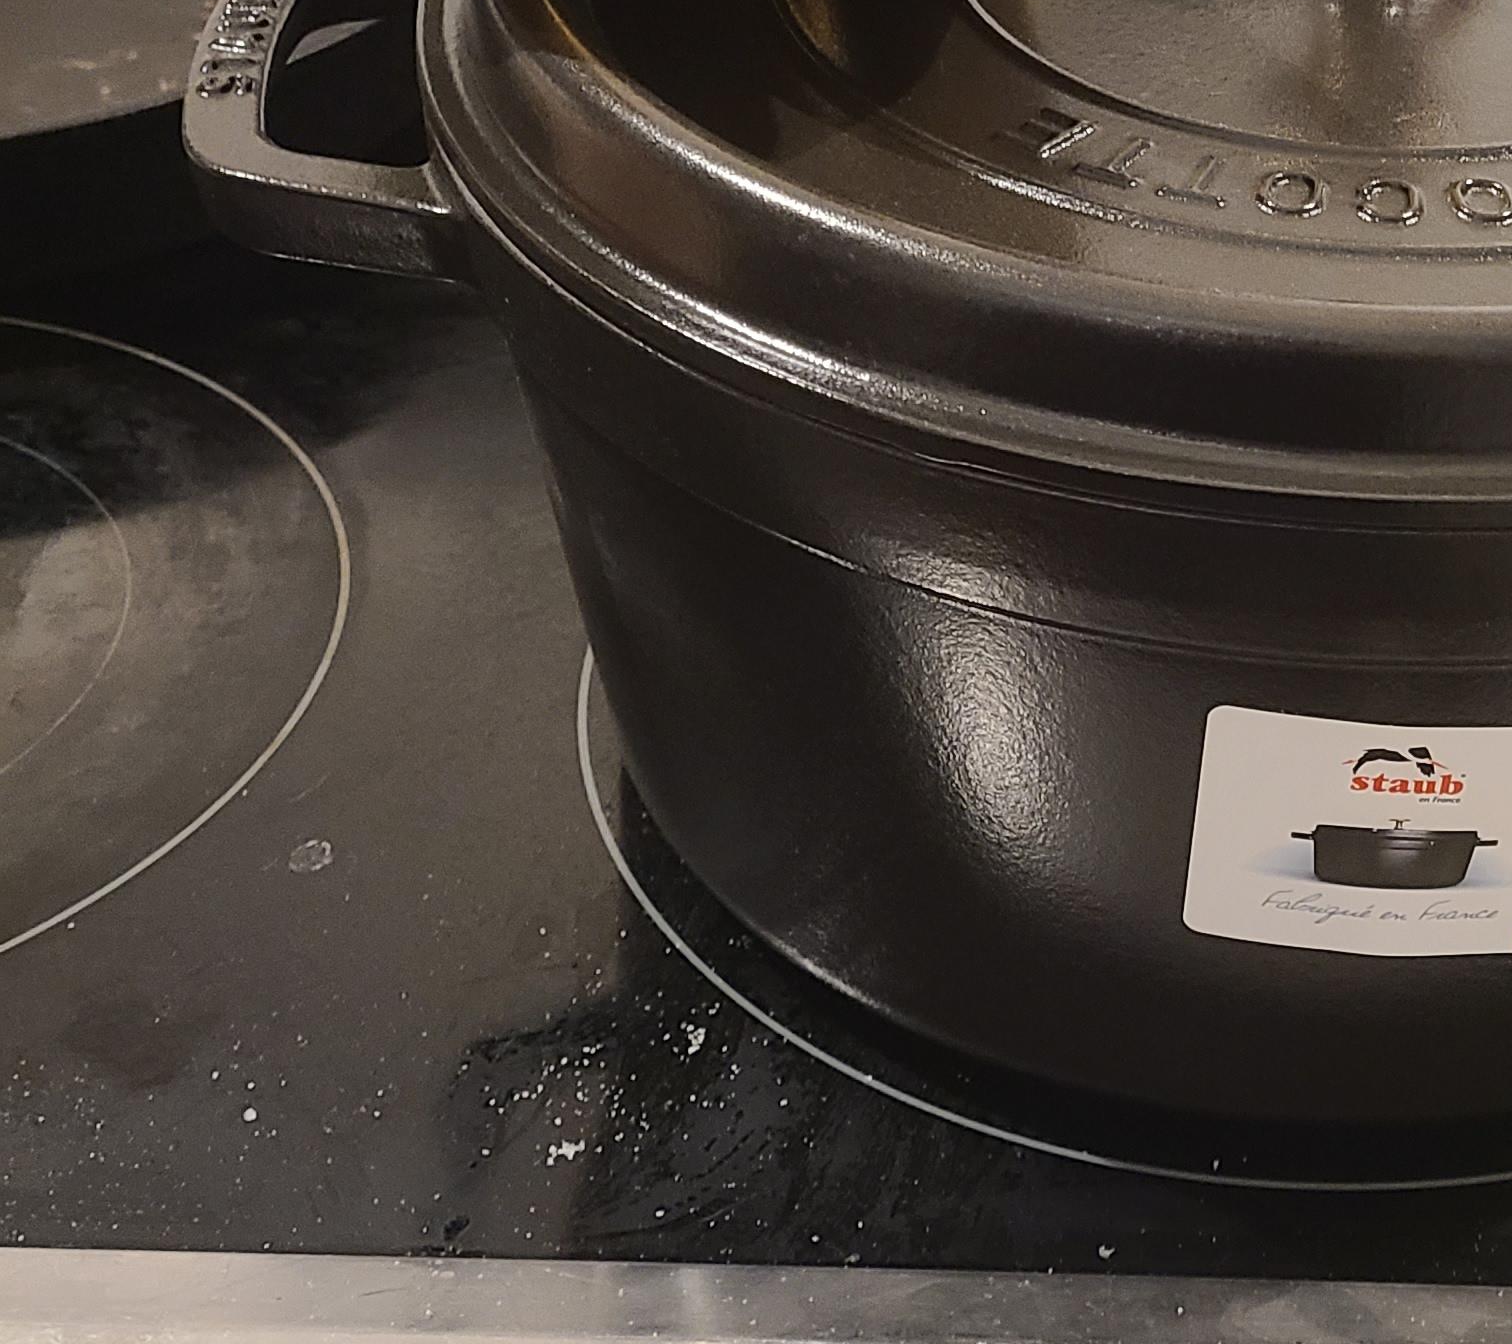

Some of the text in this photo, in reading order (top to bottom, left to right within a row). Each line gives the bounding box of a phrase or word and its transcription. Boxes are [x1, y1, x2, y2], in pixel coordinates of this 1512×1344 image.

[1350, 773, 1464, 795] staub
[1261, 890, 1499, 925] Fabriqué en France
